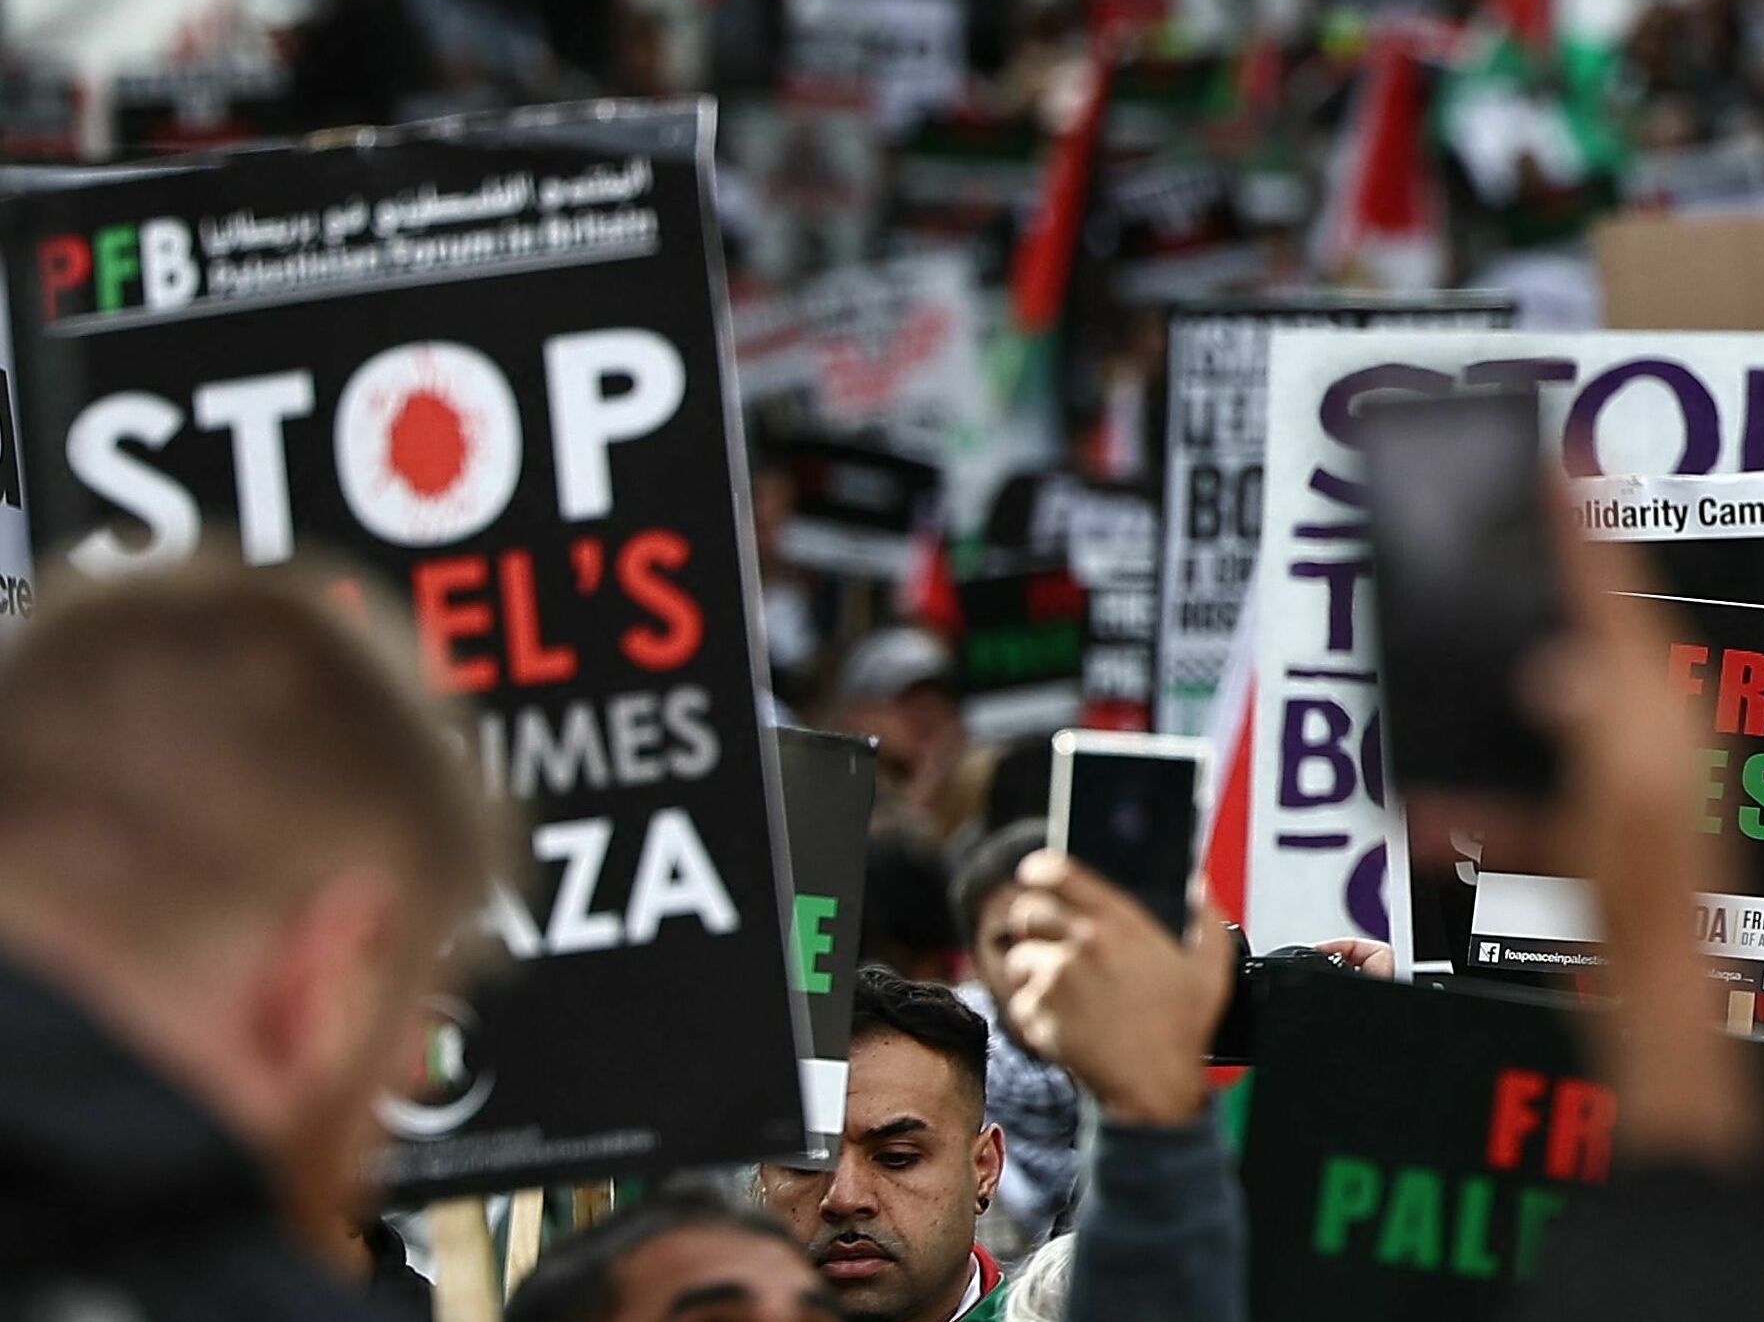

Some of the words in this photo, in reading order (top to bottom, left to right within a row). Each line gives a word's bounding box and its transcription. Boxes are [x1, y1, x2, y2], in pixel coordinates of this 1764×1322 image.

[38, 217, 198, 319] PFB
[66, 328, 687, 574] STOP
[1574, 492, 1688, 533] olidarity
[478, 806, 740, 961] ZA
[1697, 905, 1728, 945] OA
[1741, 932, 1755, 947] OF
